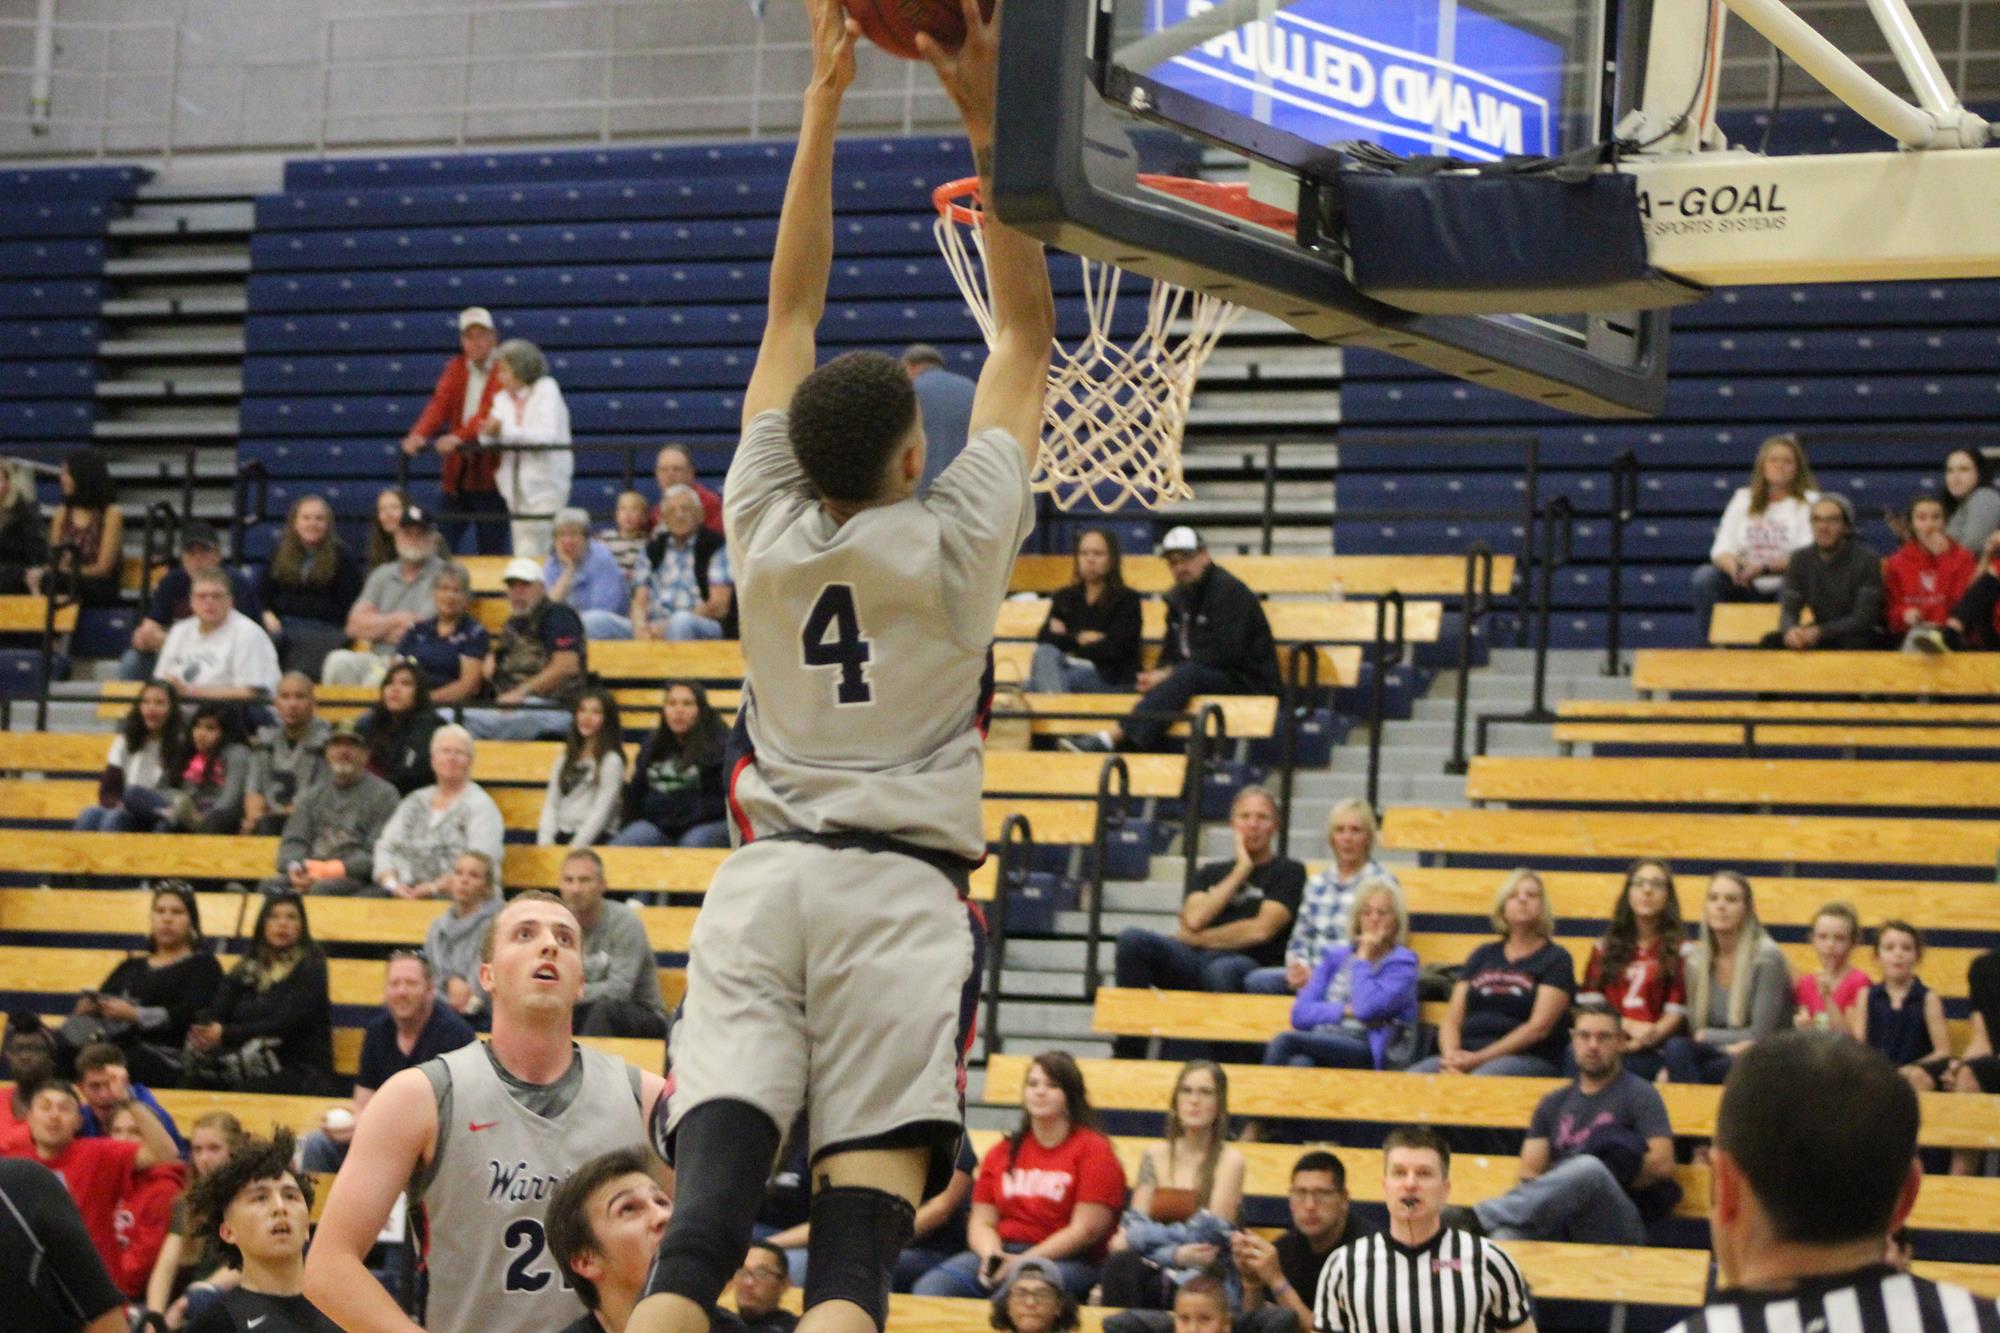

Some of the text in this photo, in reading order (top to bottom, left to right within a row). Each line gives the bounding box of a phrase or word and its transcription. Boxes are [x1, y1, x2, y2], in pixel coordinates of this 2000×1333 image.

[1655, 220, 1713, 236] SPORTS
[1718, 216, 1787, 233] SYSTEMS
[801, 582, 874, 707] 4
[488, 1159, 573, 1202] Warr
[504, 1217, 575, 1293] 2
